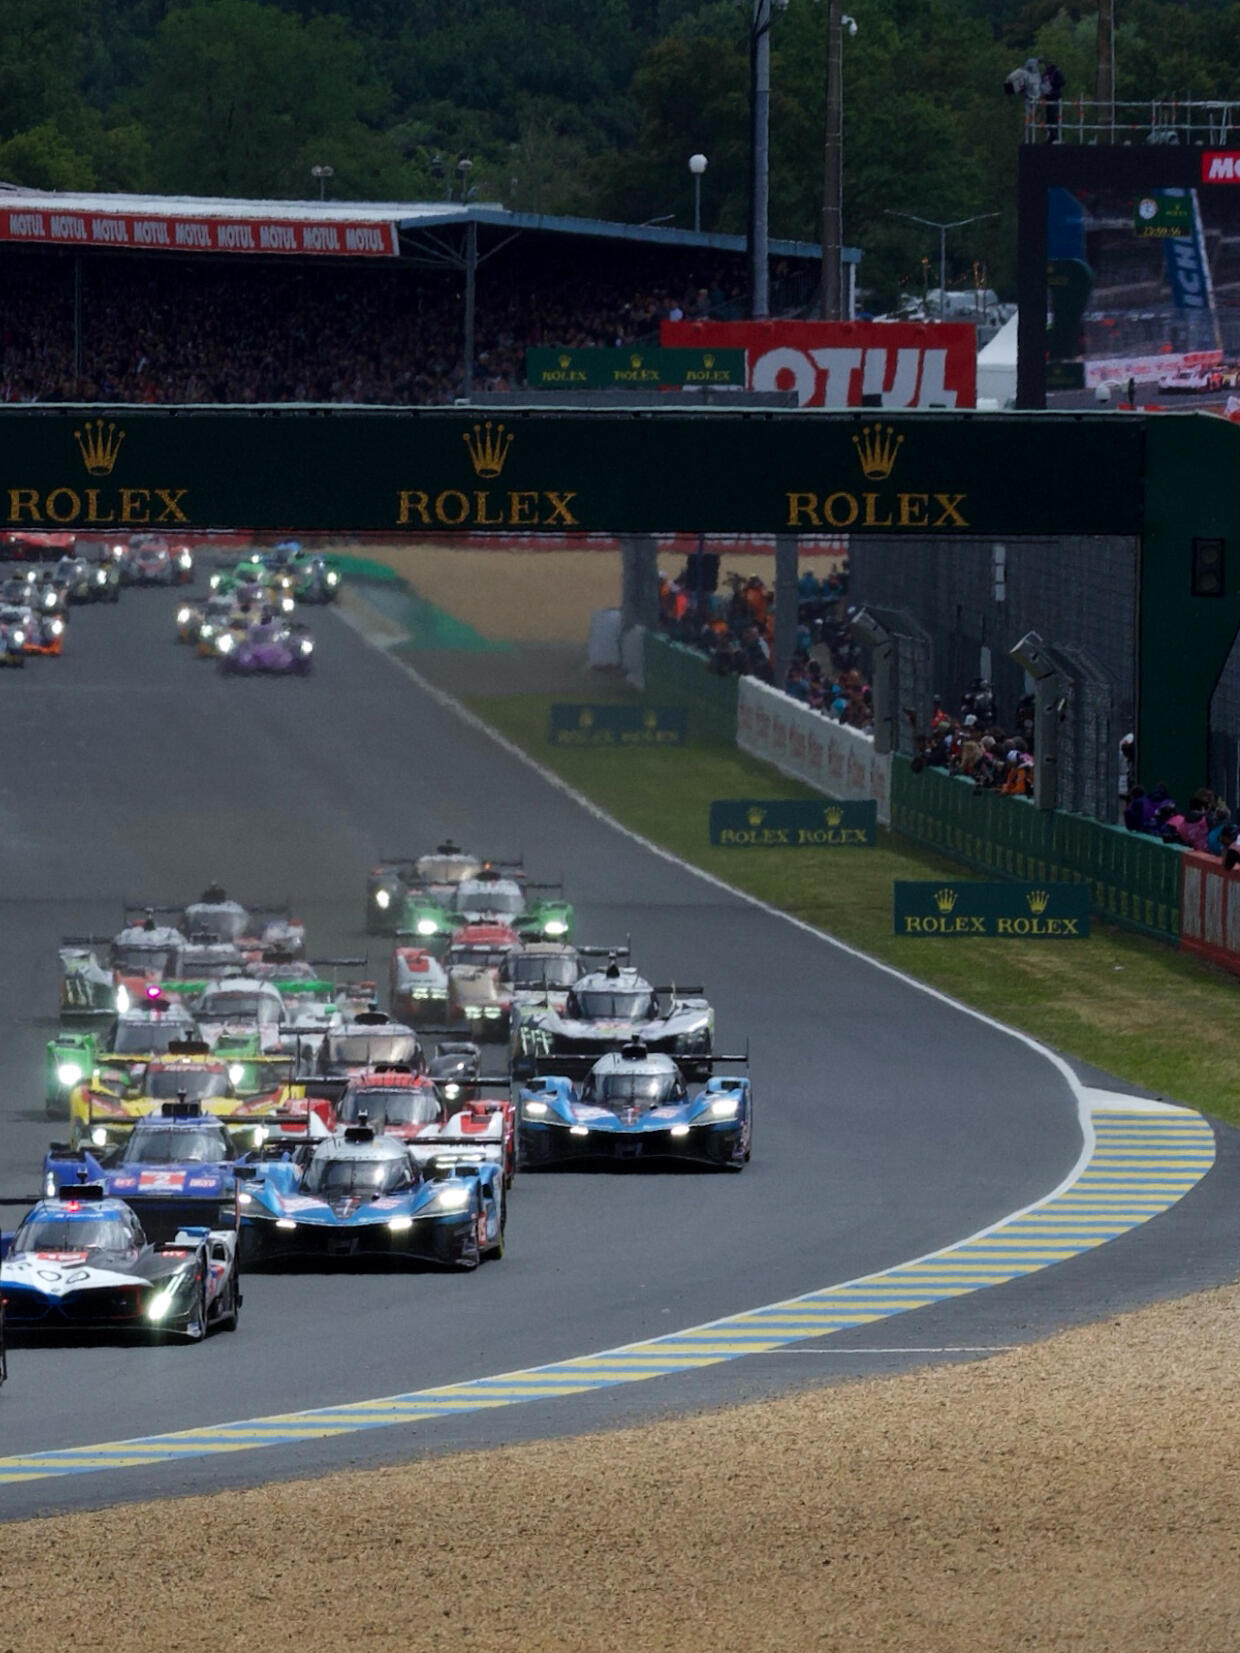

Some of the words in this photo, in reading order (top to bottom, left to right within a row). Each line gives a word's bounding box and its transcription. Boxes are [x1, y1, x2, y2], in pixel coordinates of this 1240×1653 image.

[9, 213, 46, 237] MOTUL
[50, 215, 88, 240] MOTUL
[92, 219, 129, 242] MOTUL
[133, 221, 170, 244] MOTUL
[175, 223, 212, 247] MOTUL
[217, 225, 254, 249] MOTUL
[260, 226, 297, 249] MOTUL
[303, 227, 340, 251] MOTUL
[346, 228, 384, 253] MOTUL
[7, 488, 190, 523] ROLEX
[397, 491, 580, 525] ROLEX
[786, 493, 970, 527] ROLEX
[720, 828, 791, 845] ROLEX
[799, 828, 869, 845] ROLEX
[905, 916, 987, 935] ROLEX
[997, 917, 1079, 935] ROLEX
